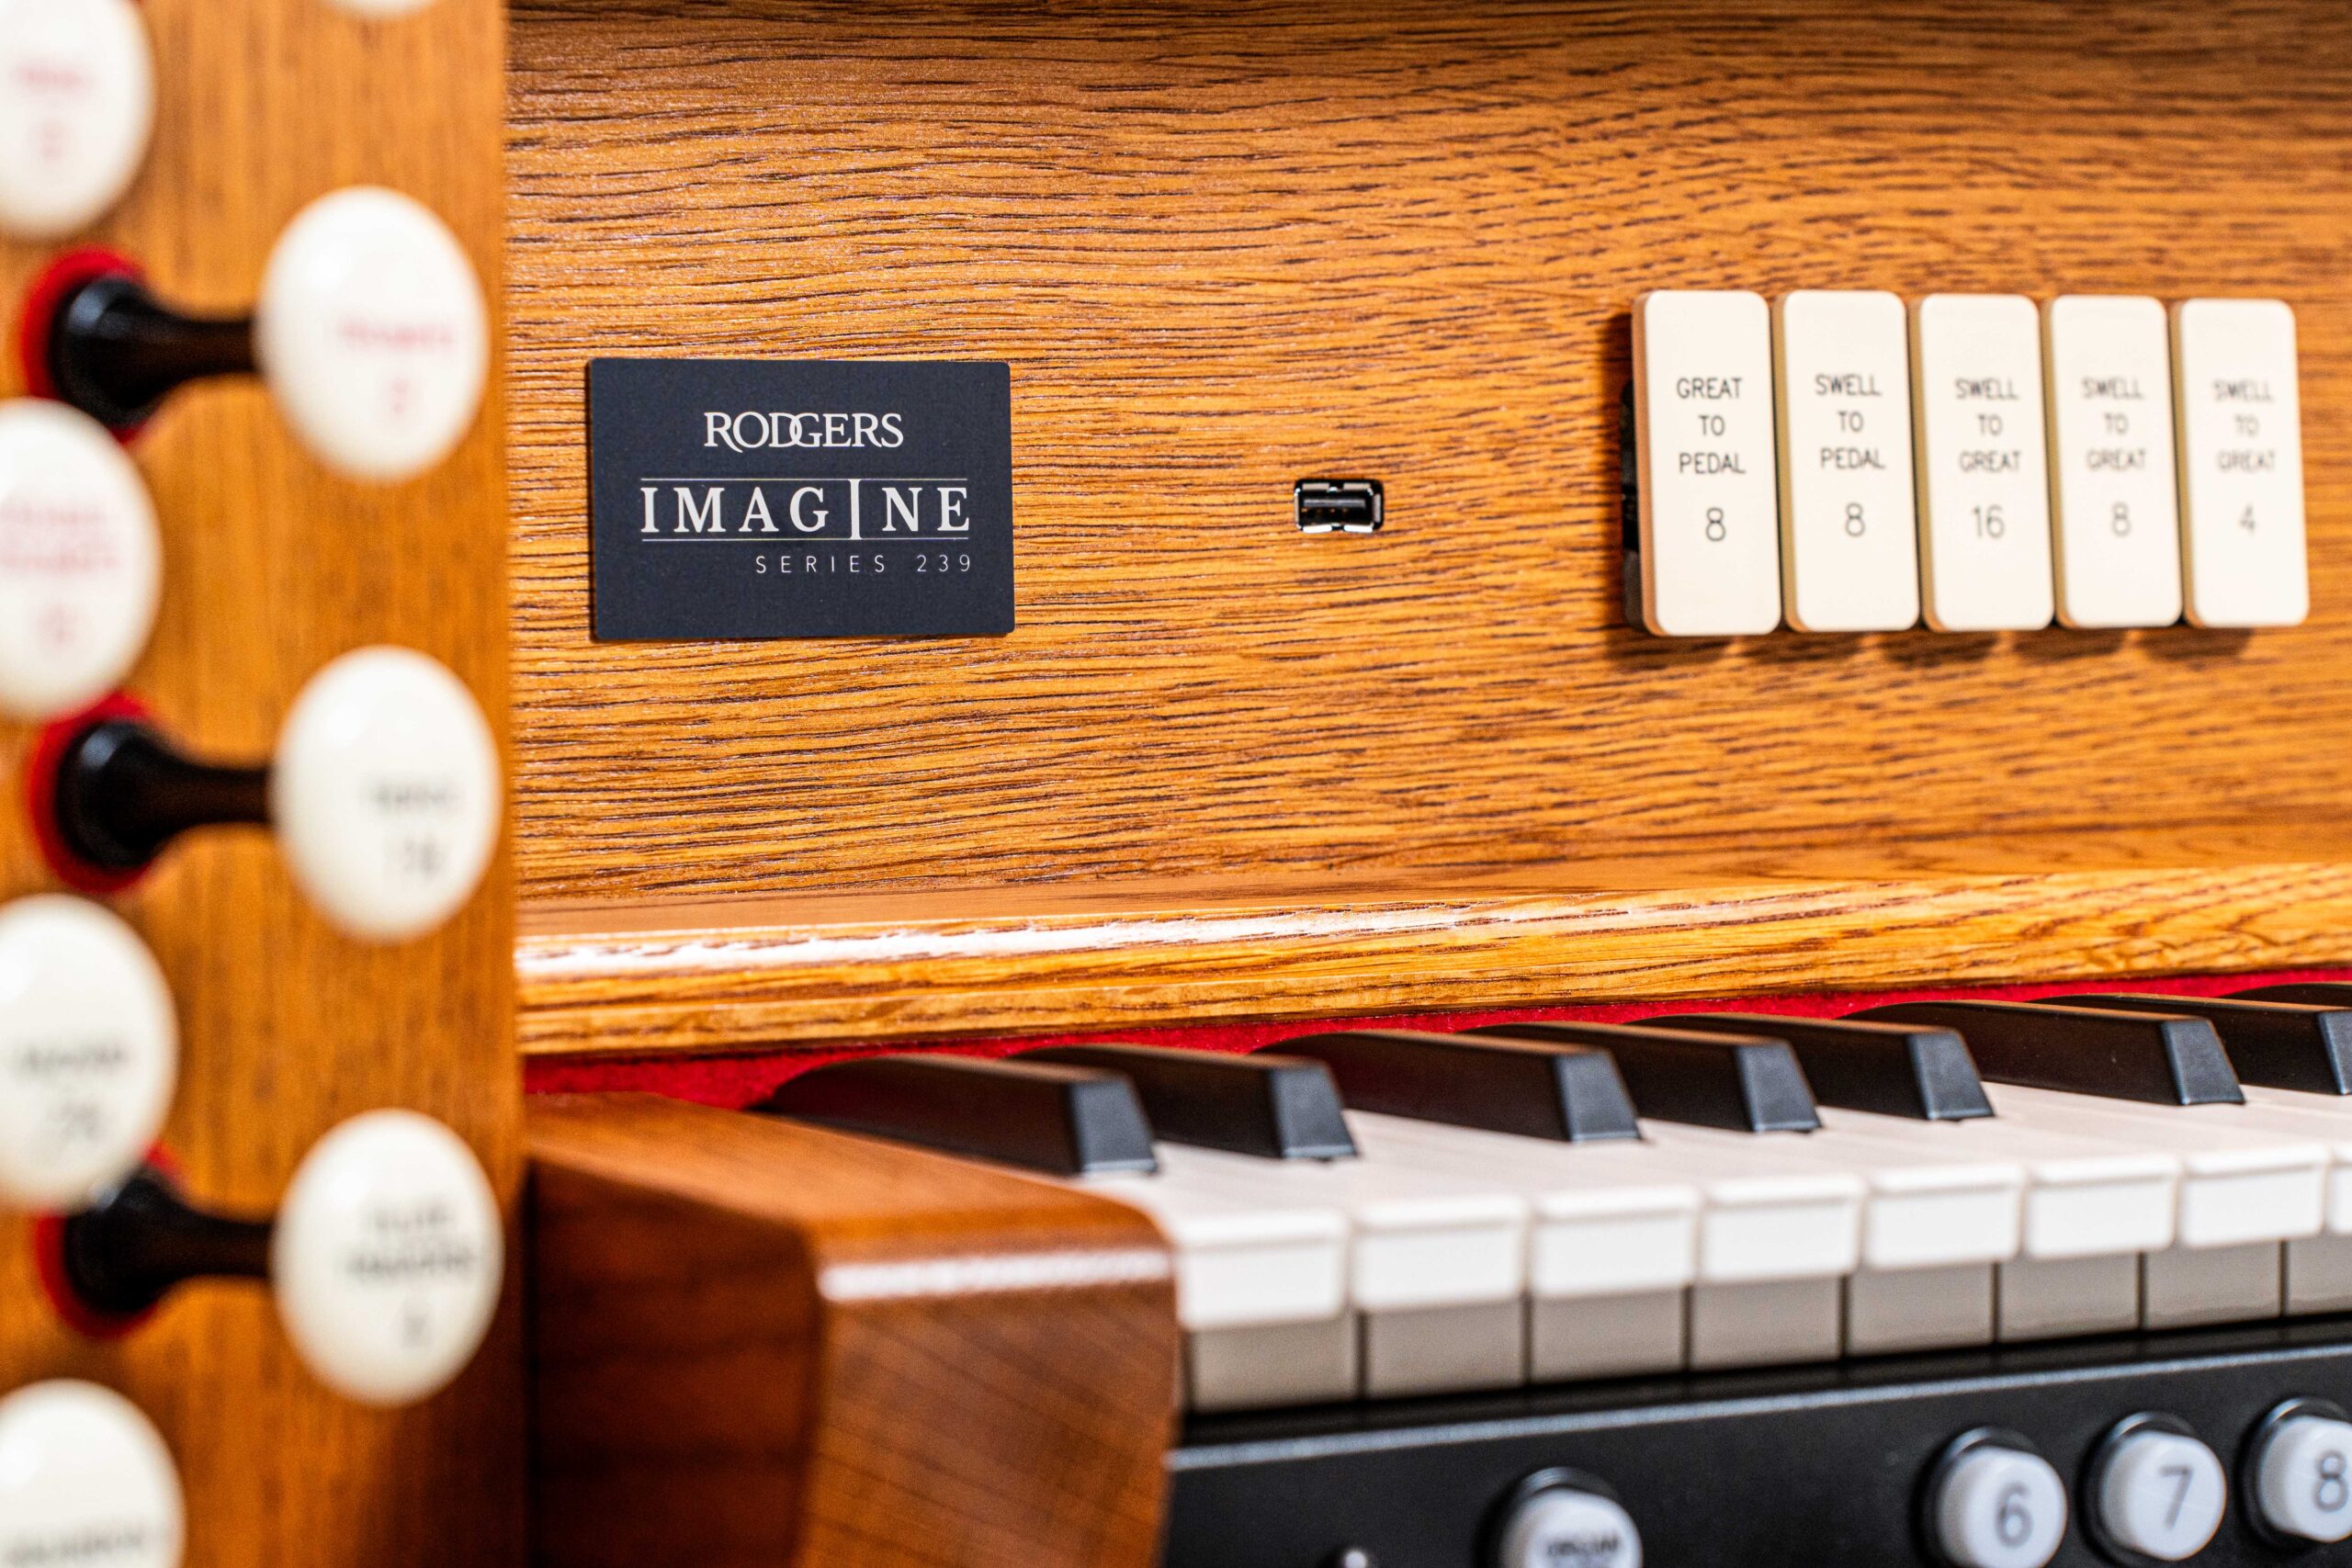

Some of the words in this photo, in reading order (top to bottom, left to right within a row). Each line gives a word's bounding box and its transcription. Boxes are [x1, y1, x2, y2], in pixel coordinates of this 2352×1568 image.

[1677, 377, 1743, 399] GREAT
[1815, 373, 1882, 396] SWELL
[1954, 378, 2018, 400] SWELL
[2081, 378, 2145, 400] SWELL
[2212, 380, 2275, 401] SWELL
[704, 412, 904, 453] RODGERS
[1699, 415, 1725, 436] TO
[1837, 411, 1864, 433] TO
[1977, 413, 2003, 435] TO
[2104, 413, 2129, 435] TO
[2234, 415, 2259, 436] TO
[1679, 452, 1746, 474] PEDAL
[1820, 447, 1885, 469] PEDAL
[1959, 451, 2021, 472] GREAT
[2086, 450, 2146, 472] GREAT
[2218, 451, 2276, 472] GREAT
[640, 478, 970, 540] IMAGINE
[1845, 502, 1866, 537] 8
[2111, 502, 2132, 538] 8
[2238, 505, 2257, 535] 4
[1705, 507, 1726, 542] 8
[1973, 505, 2006, 538] 16
[755, 555, 886, 574] SERIES
[917, 554, 971, 572] 239
[2313, 1450, 2350, 1512] 8
[2159, 1465, 2194, 1529] 7
[1995, 1481, 2034, 1547] 6
